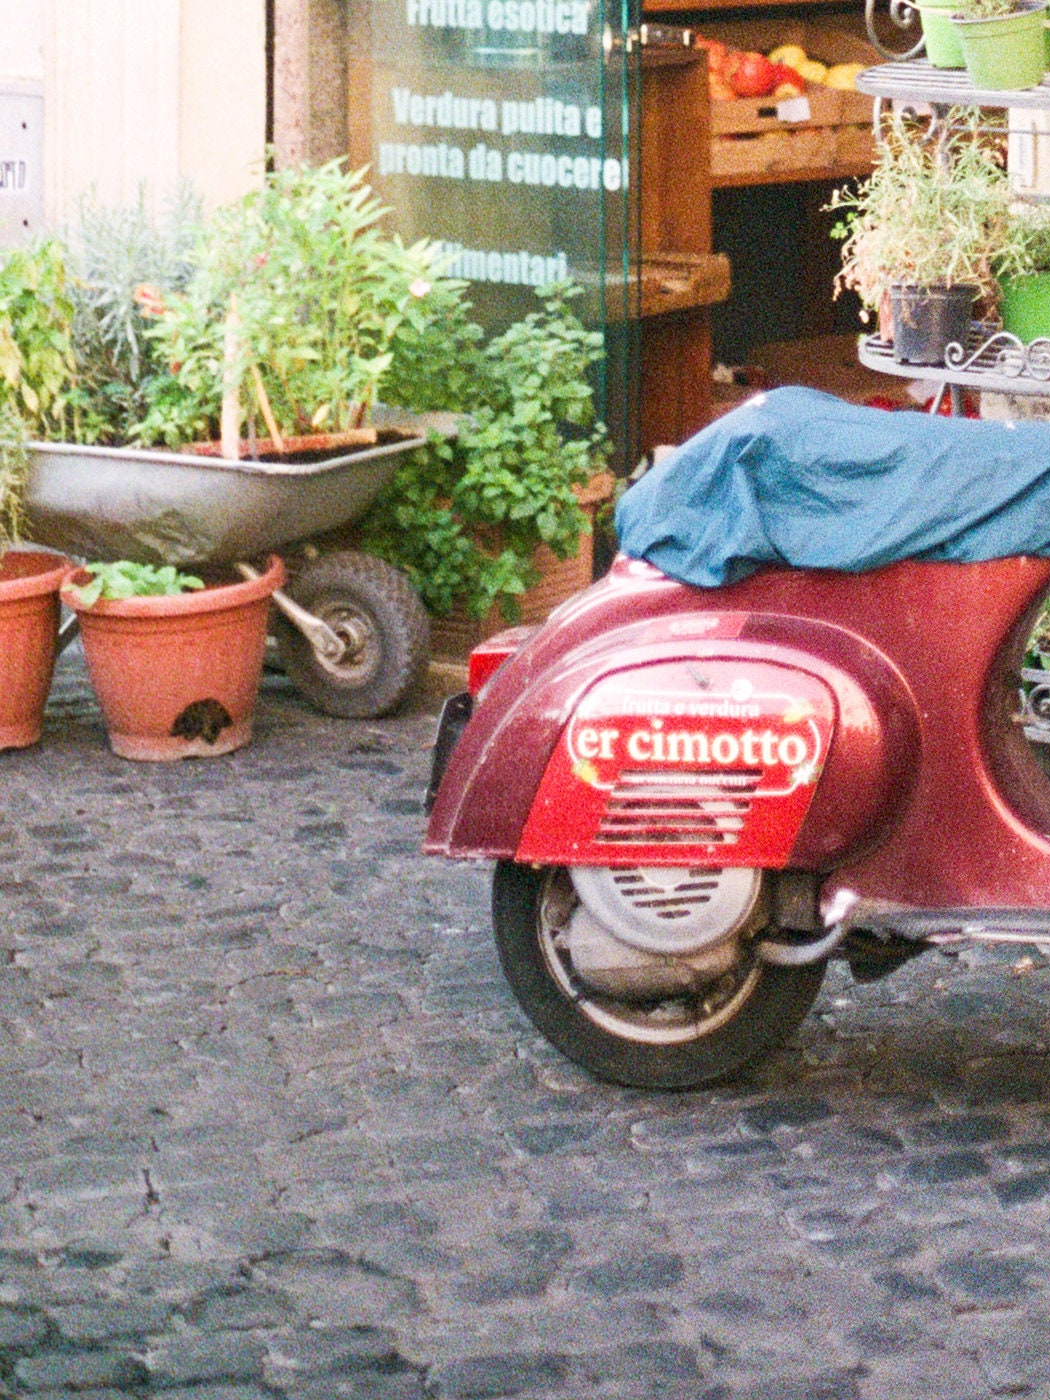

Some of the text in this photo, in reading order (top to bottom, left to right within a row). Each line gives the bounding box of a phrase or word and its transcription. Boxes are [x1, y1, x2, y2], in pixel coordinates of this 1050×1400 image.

[393, 87, 497, 131] Verdura
[502, 94, 582, 139] pulita
[380, 141, 464, 178] pronta
[469, 142, 500, 182] da
[622, 695, 760, 717] frutta e verdura
[577, 718, 807, 765] er cimotto
